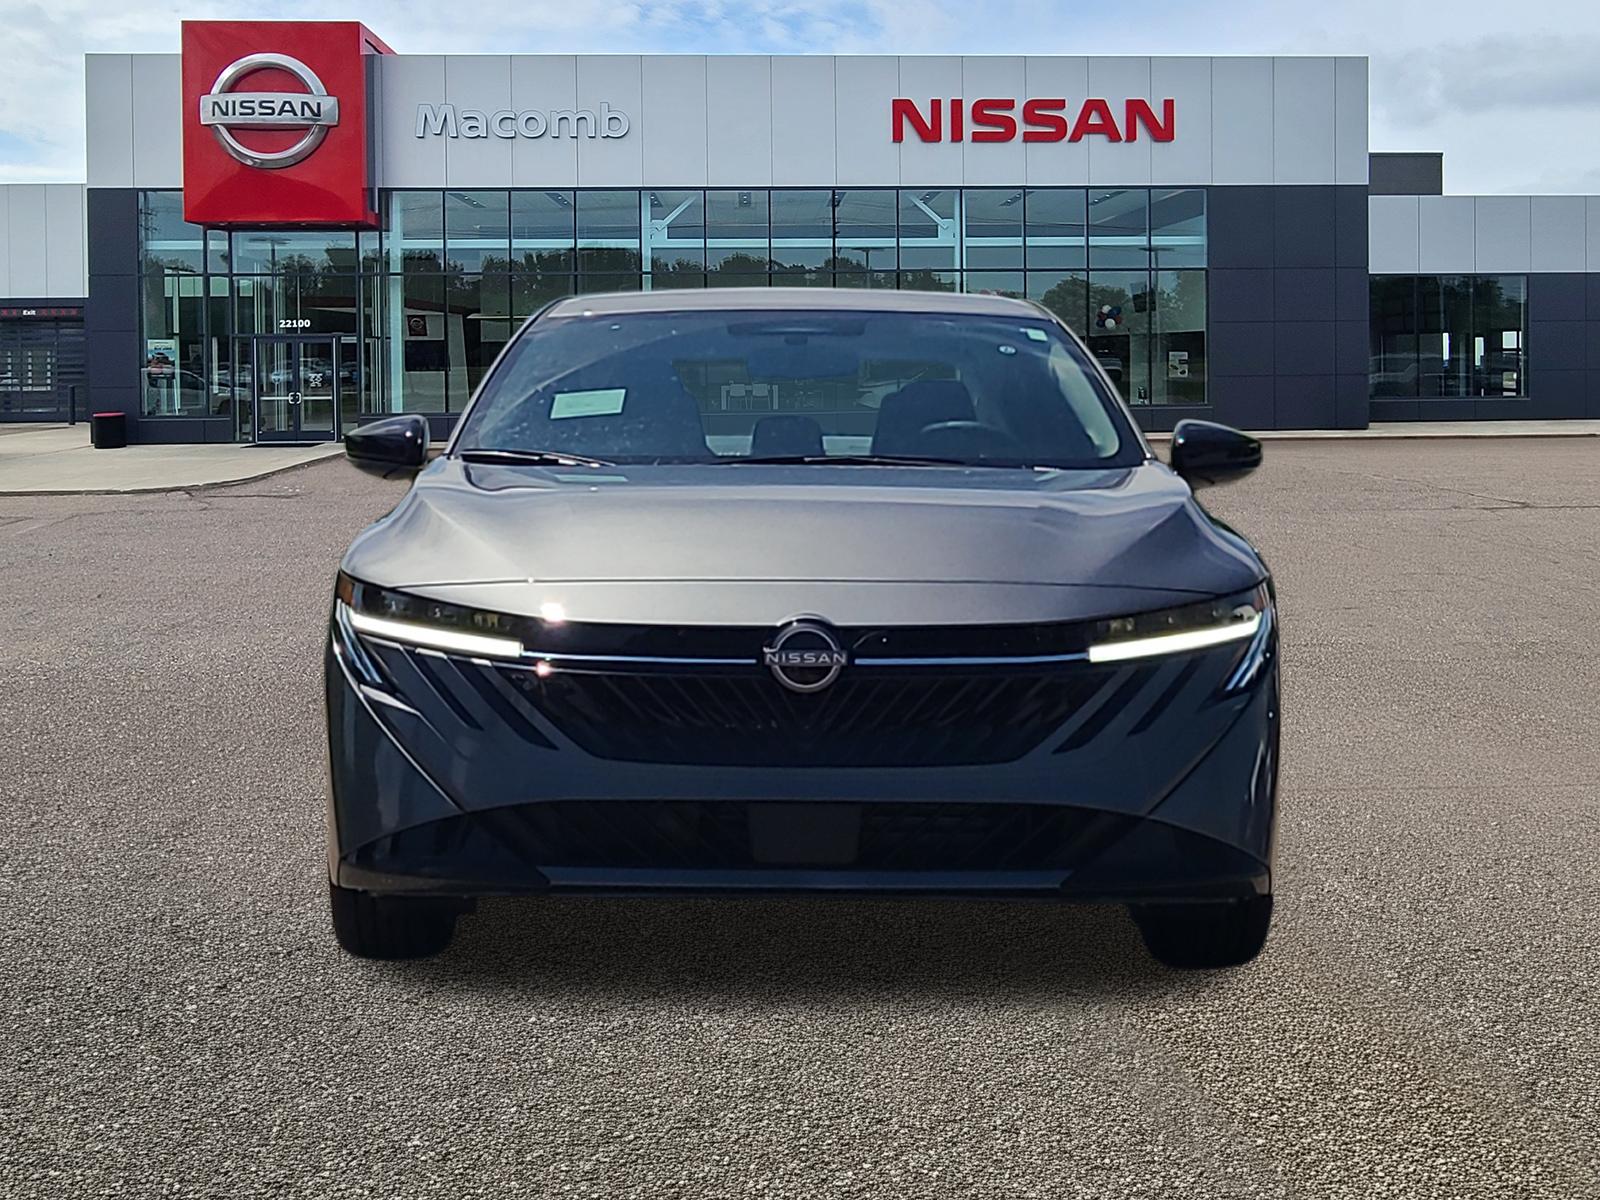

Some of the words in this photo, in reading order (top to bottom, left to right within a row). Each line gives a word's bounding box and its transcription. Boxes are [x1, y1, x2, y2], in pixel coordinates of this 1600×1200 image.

[212, 100, 322, 118] NISSAN
[415, 102, 630, 139] Macomb
[892, 98, 1176, 143] NISSAN
[279, 319, 311, 328] 22100
[766, 652, 846, 664] NISSAN
